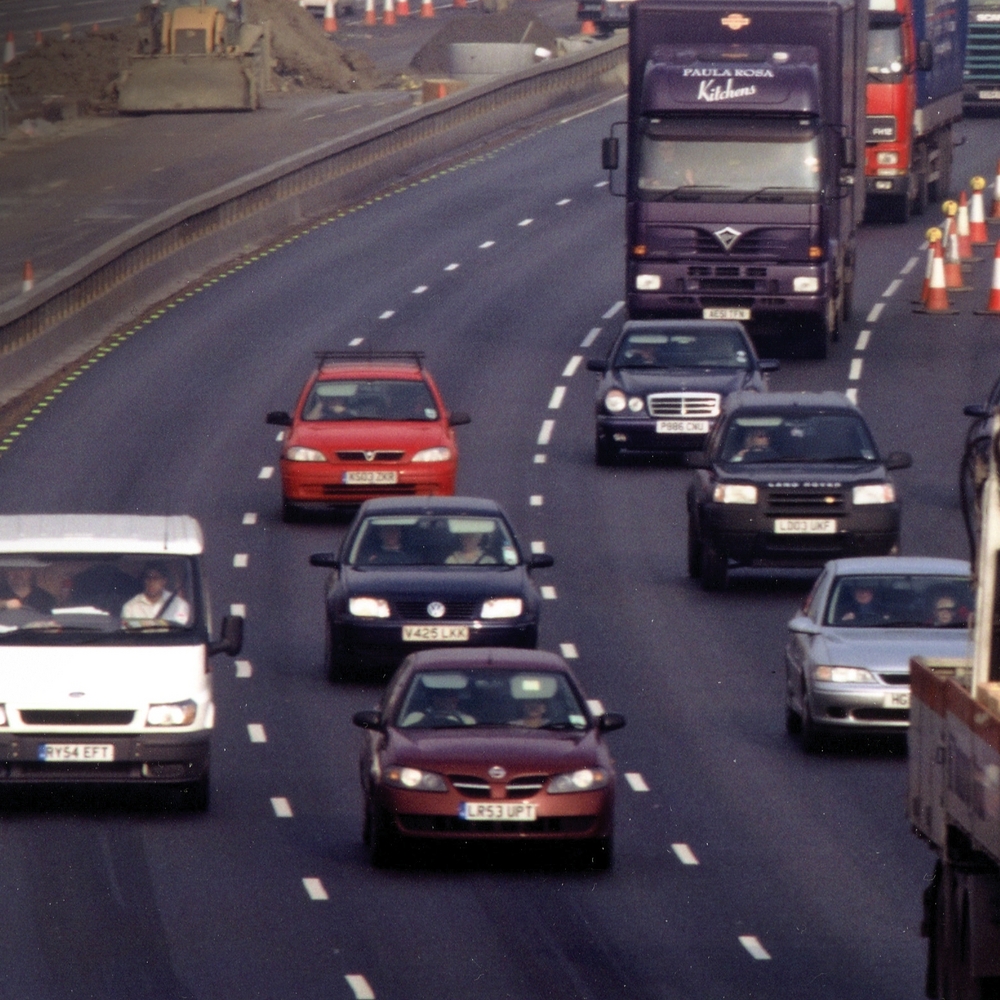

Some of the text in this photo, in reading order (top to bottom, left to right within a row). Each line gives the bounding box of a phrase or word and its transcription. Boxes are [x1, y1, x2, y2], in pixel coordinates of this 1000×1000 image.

[683, 68, 775, 78] PAULA ROSA
[697, 78, 758, 102] Kitchens
[872, 128, 893, 136] FH12
[404, 627, 465, 639] V425 LKK
[46, 746, 108, 759] RY54 EFT
[468, 804, 532, 818] LR53 UPT
